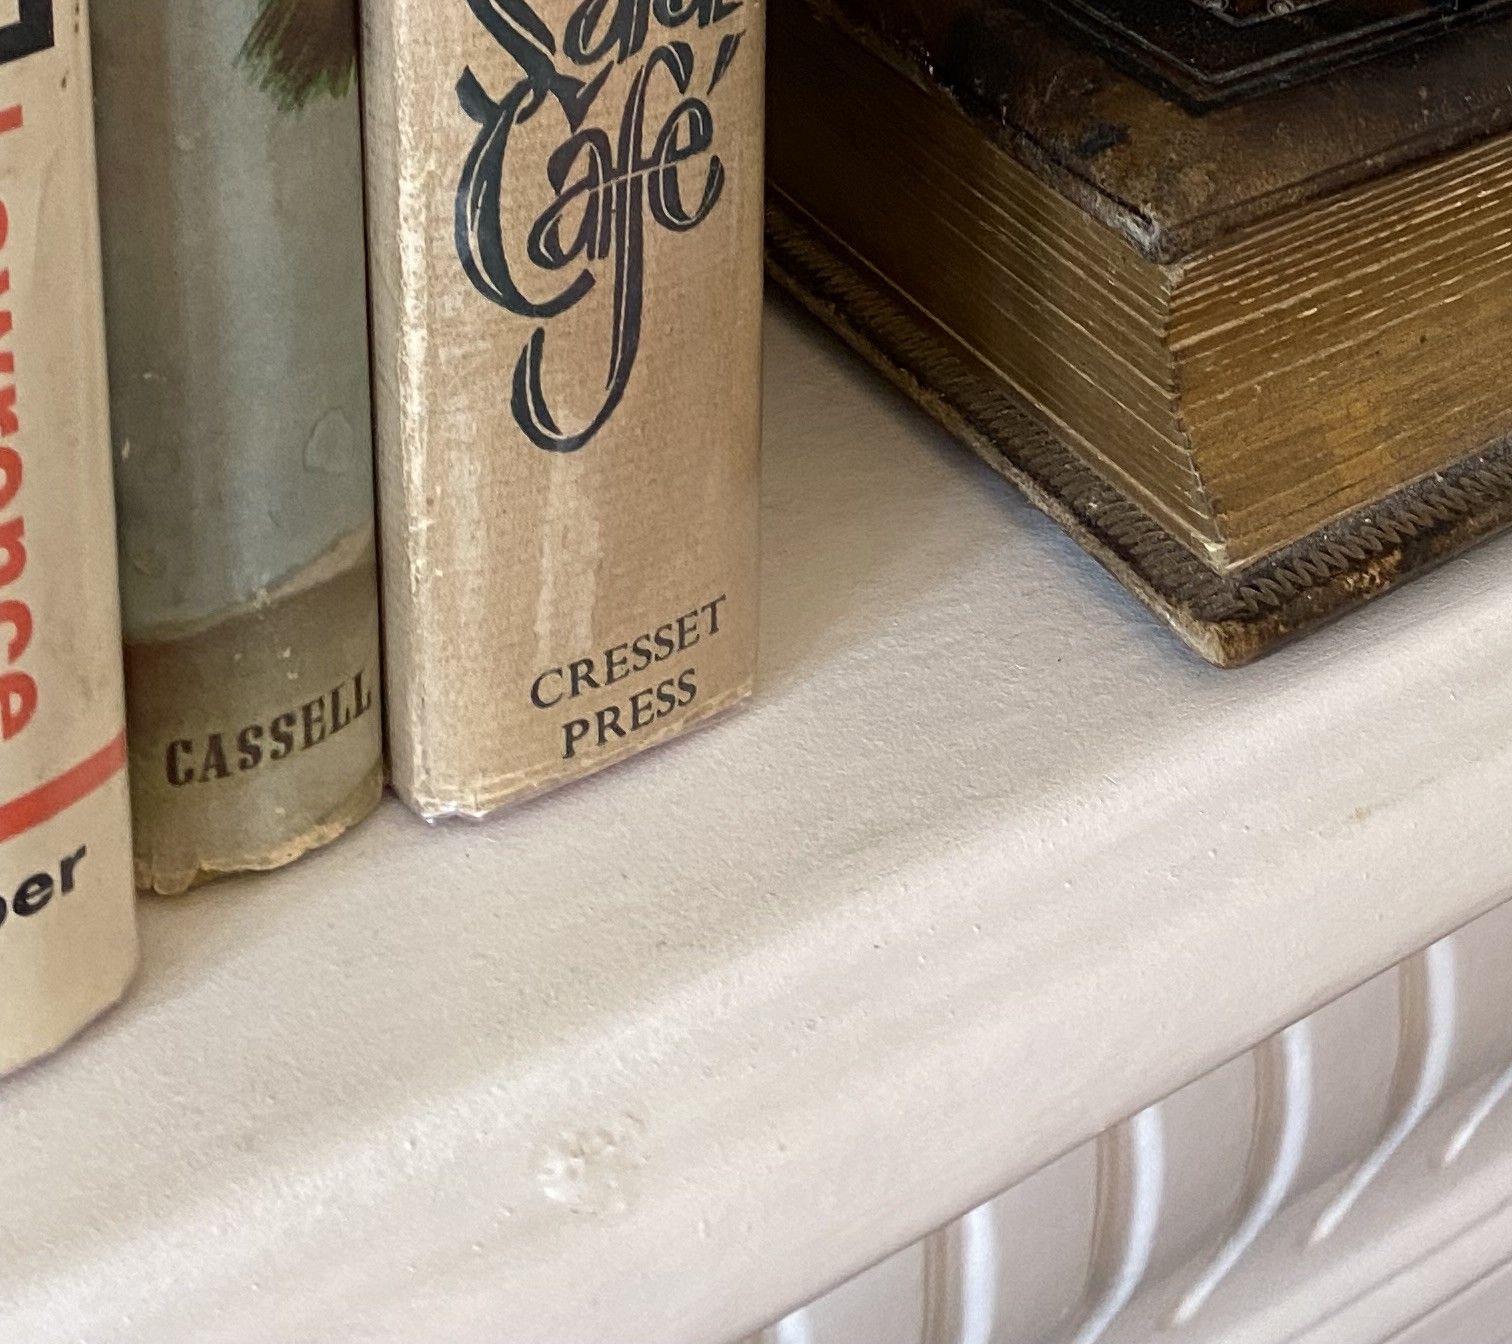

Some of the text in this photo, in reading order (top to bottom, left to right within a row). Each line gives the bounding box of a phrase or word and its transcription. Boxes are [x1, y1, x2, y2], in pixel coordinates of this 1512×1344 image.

[530, 594, 729, 711] CRESSET
[164, 670, 372, 790] CASSELL
[562, 667, 698, 760] PRESS
[0, 844, 87, 928] er
